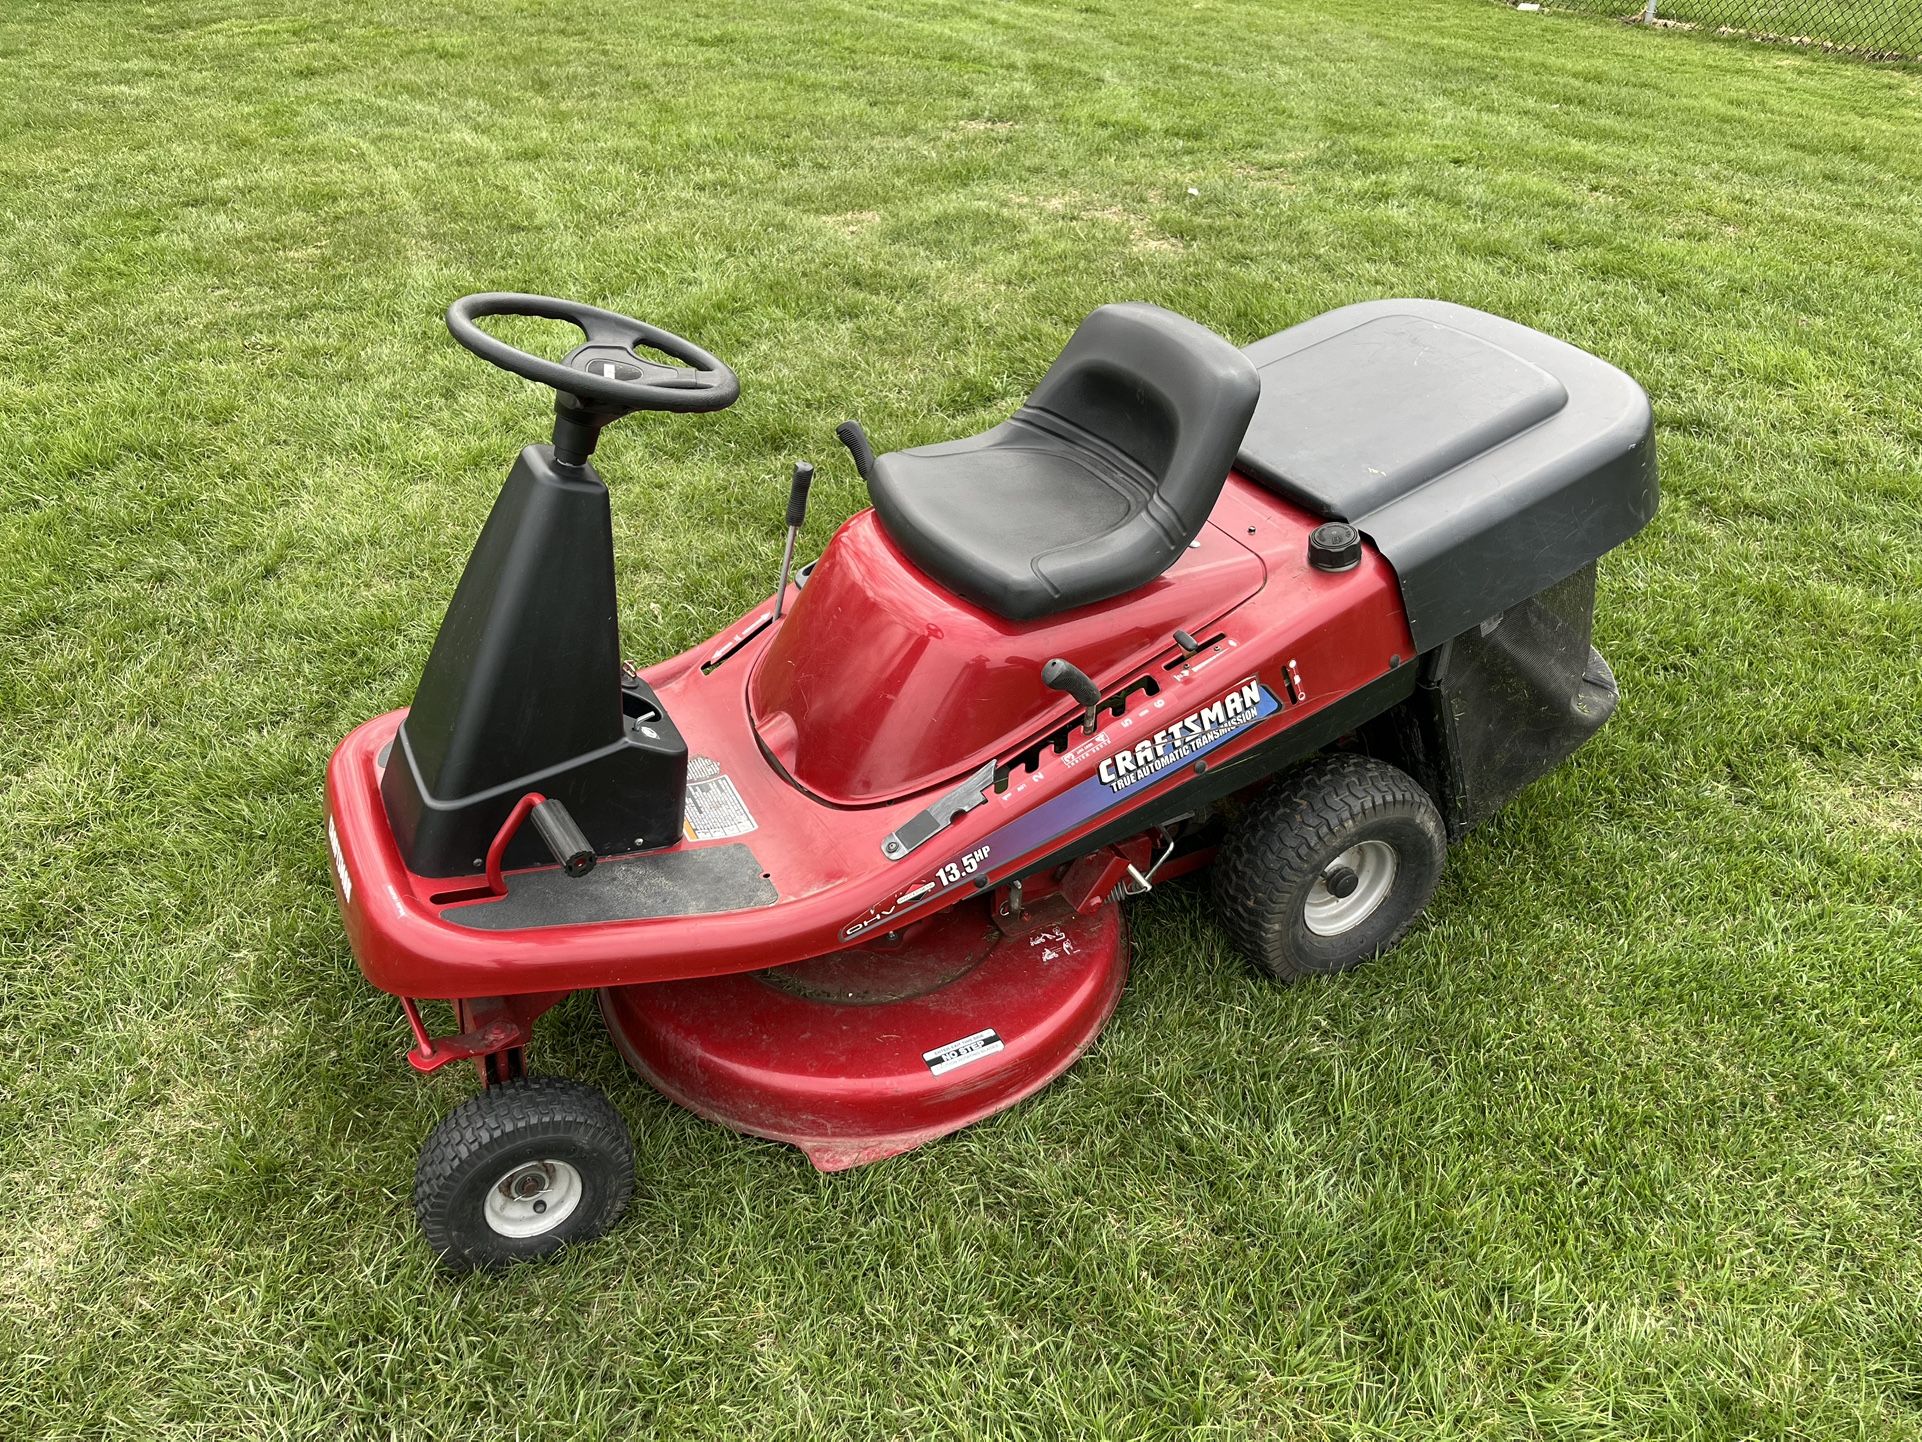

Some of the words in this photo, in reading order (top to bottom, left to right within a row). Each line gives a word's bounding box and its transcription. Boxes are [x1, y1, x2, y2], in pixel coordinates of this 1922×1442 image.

[1098, 679, 1261, 783] CRAFTSMAN
[1111, 773, 1137, 793] TRUE
[1137, 745, 1190, 781] AUTOMATIC
[1191, 706, 1258, 752] TRANSMISSION
[846, 905, 896, 935] OHV
[941, 1050, 958, 1062] NO
[958, 1040, 985, 1055] STEP
